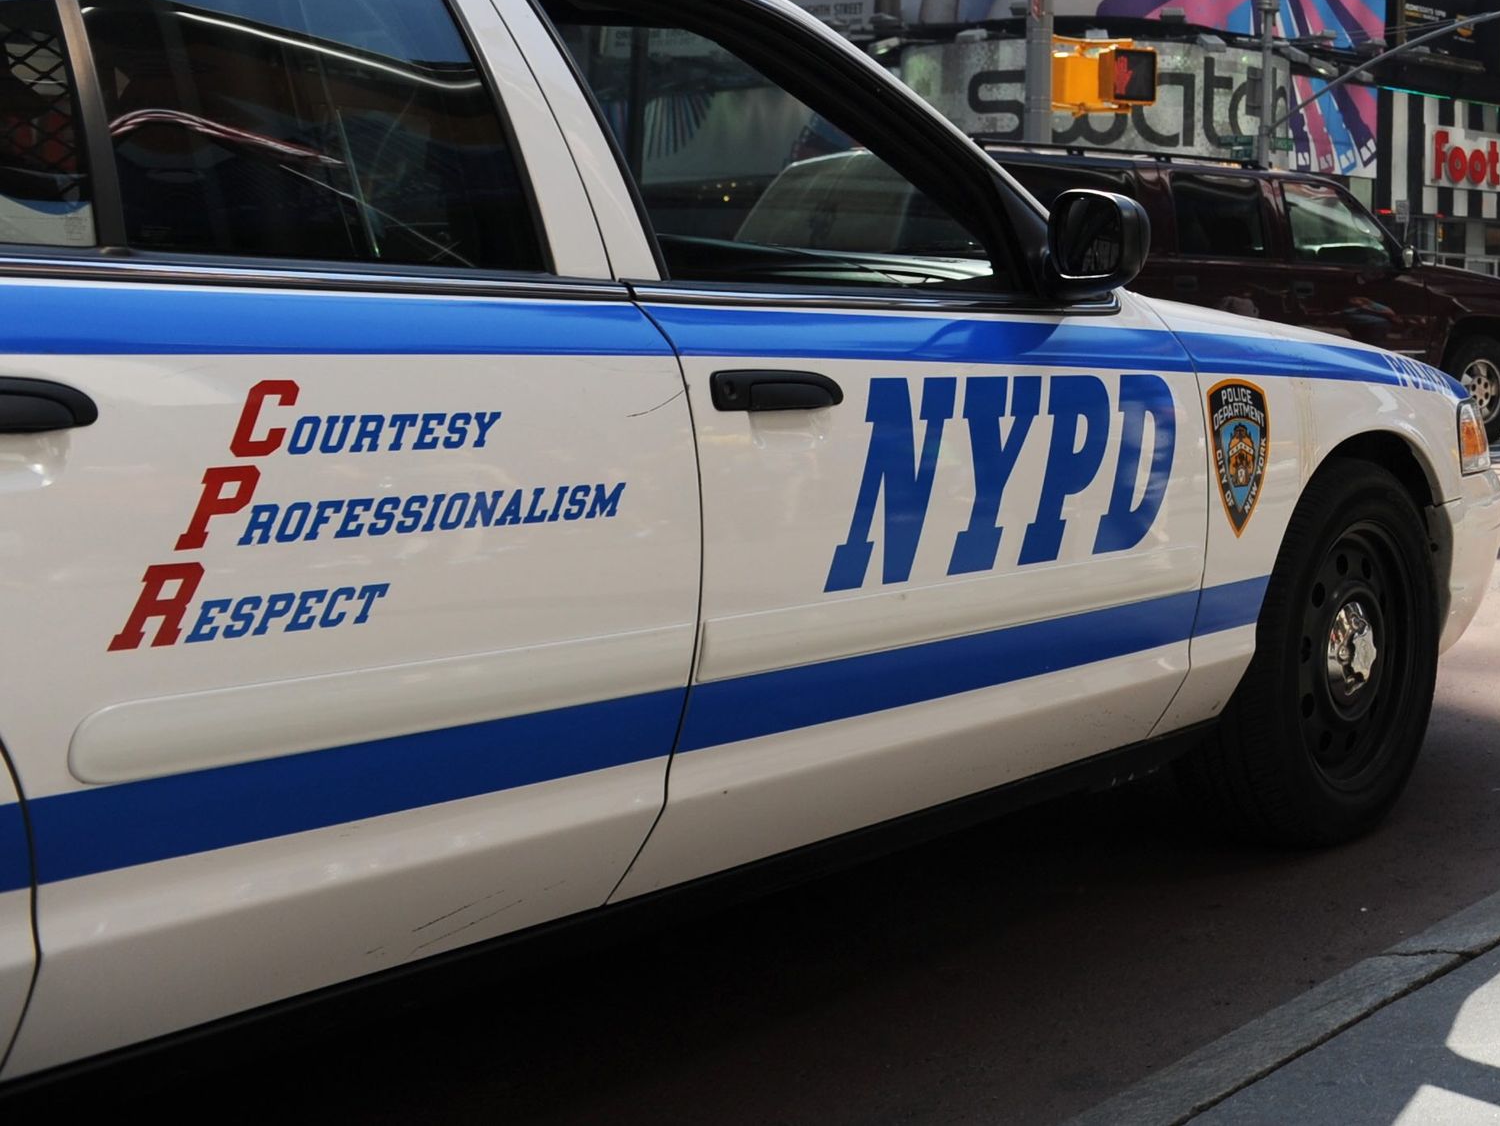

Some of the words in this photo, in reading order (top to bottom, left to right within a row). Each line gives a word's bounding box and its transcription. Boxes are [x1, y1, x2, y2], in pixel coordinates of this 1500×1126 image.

[1433, 130, 1500, 187] Foot
[230, 379, 501, 457] COURTESY
[1214, 402, 1265, 430] DEPARTMENT
[1221, 387, 1253, 405] POLICE
[174, 464, 626, 551] PROFESSIONALISM
[824, 375, 1175, 592] NYPD
[1216, 449, 1229, 484] CITY
[1225, 489, 1235, 508] OF
[1244, 485, 1258, 514] NEW
[1256, 437, 1267, 475] YORK
[107, 561, 390, 651] RESPECT
